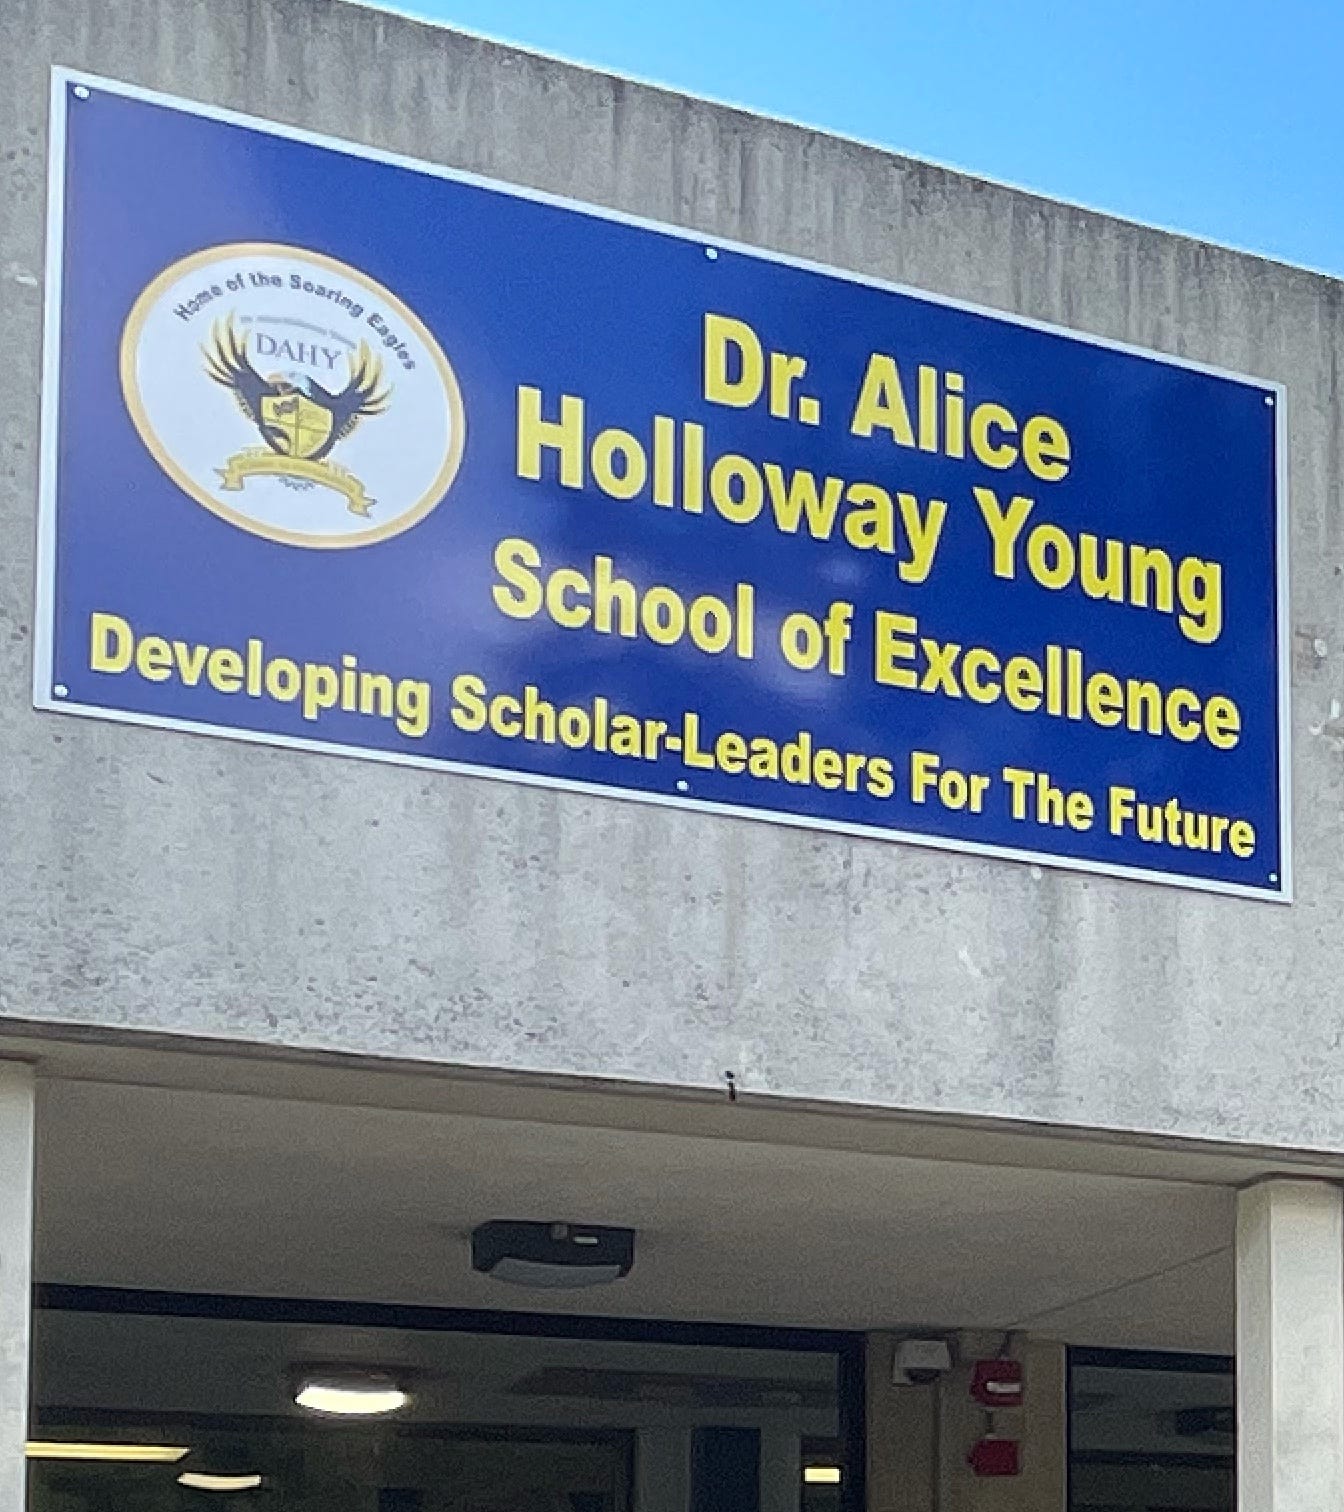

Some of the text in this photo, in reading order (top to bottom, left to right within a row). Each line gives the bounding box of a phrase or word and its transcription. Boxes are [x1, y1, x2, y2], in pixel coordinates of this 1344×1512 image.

[256, 332, 342, 370] DAHY
[704, 313, 1071, 482] Dr. Alice
[516, 386, 1223, 644] Holloway Young
[90, 613, 1256, 857] Developing Scholar-Leaders For The Future
[493, 537, 1241, 750] School of Excellence
